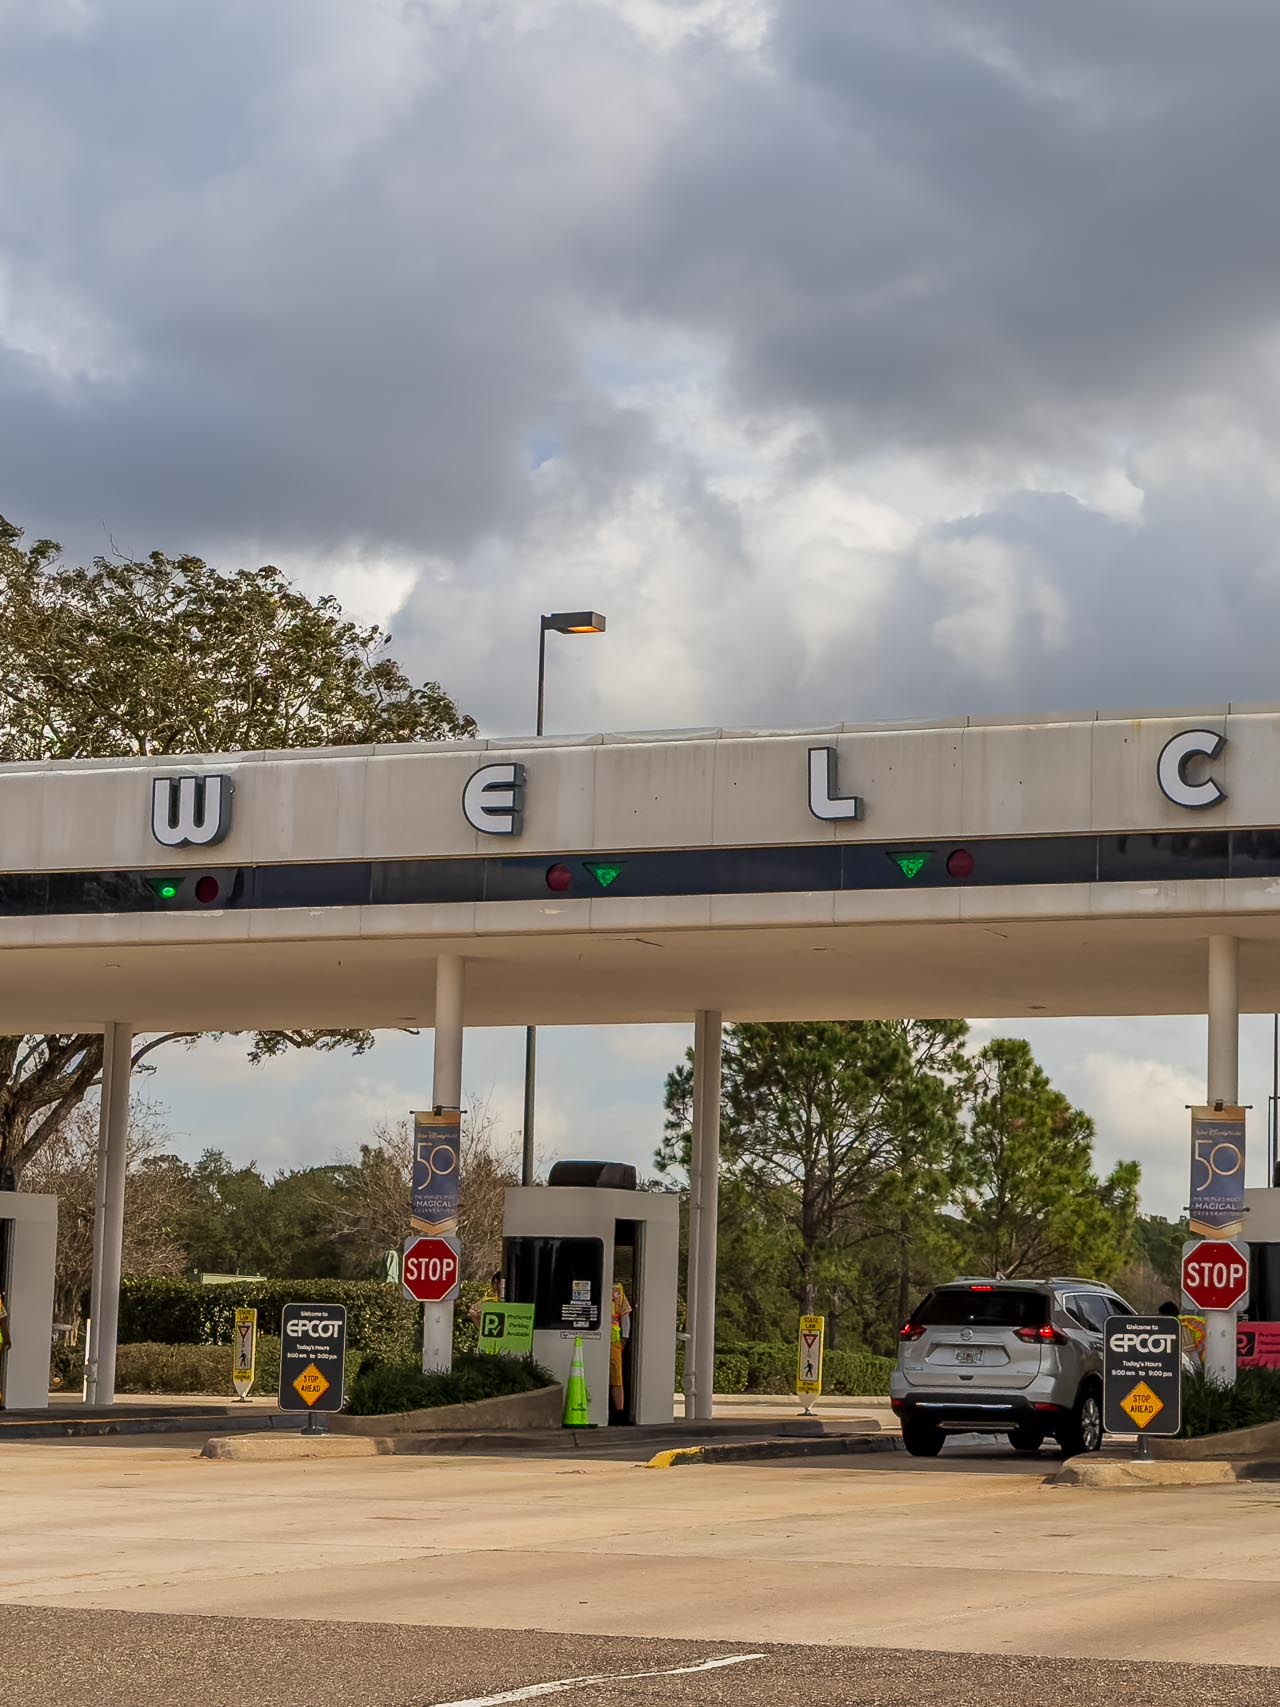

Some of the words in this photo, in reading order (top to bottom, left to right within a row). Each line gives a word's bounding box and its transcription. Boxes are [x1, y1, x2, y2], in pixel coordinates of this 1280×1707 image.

[417, 1142, 456, 1190] 50
[1195, 1139, 1242, 1191] 50
[1195, 1202, 1237, 1210] MAGICAL
[406, 1257, 454, 1281] STOP
[1186, 1262, 1243, 1288] STOP
[286, 1320, 343, 1338] EPCOT
[1109, 1333, 1177, 1353] EPCOT
[1123, 1360, 1144, 1368] Today's
[303, 1375, 319, 1383] STOP
[301, 1384, 321, 1392] AHEAD
[1133, 1394, 1151, 1403] STOP
[1130, 1405, 1154, 1413] AHEAD
